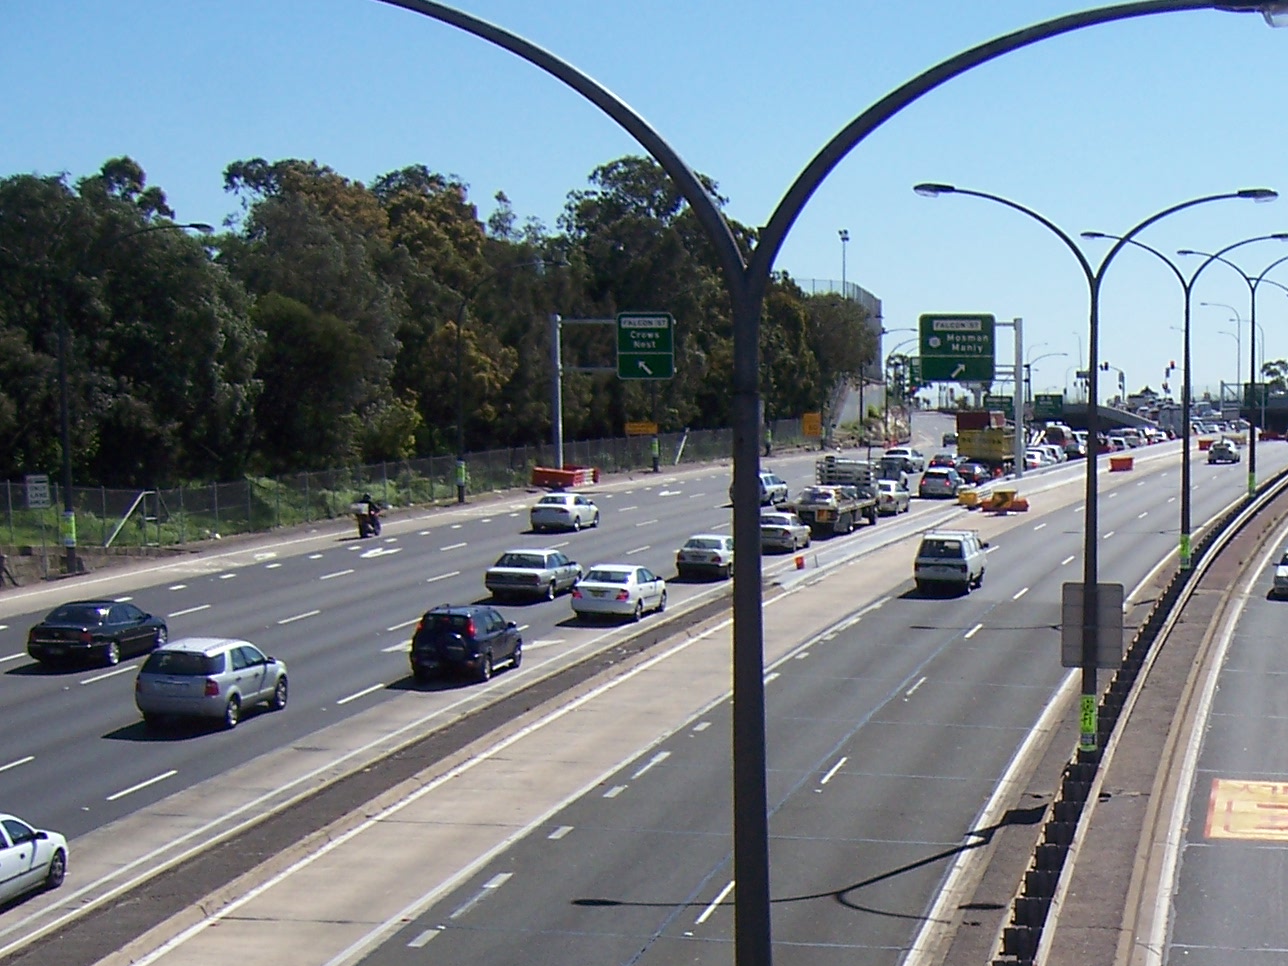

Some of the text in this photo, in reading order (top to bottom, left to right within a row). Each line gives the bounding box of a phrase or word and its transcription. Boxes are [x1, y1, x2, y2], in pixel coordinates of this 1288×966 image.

[630, 330, 660, 339] Crows
[946, 334, 989, 342] Mosman
[633, 340, 656, 349] Nest
[951, 343, 984, 354] Manly
